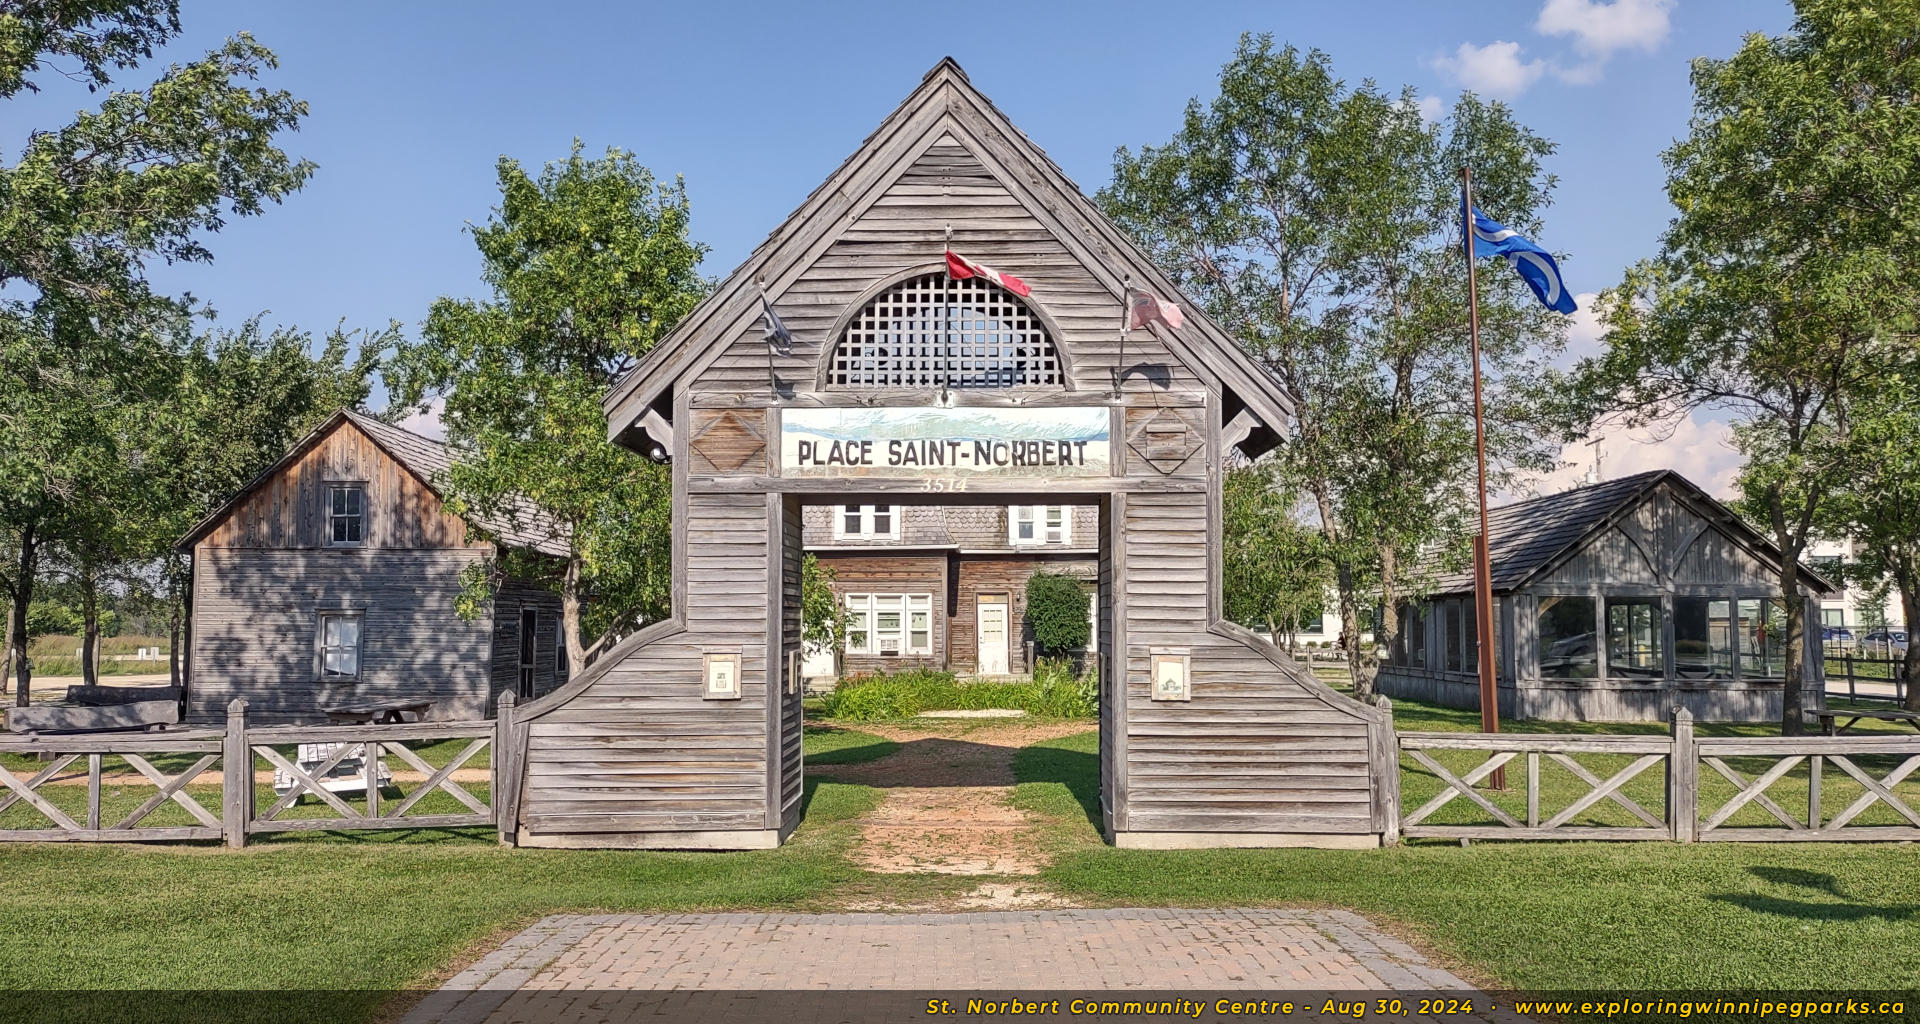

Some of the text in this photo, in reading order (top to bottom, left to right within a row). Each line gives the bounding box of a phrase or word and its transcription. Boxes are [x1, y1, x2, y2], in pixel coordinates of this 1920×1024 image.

[798, 440, 1087, 466] PLACE SAINT-NORBERT
[920, 477, 968, 493] 3514
